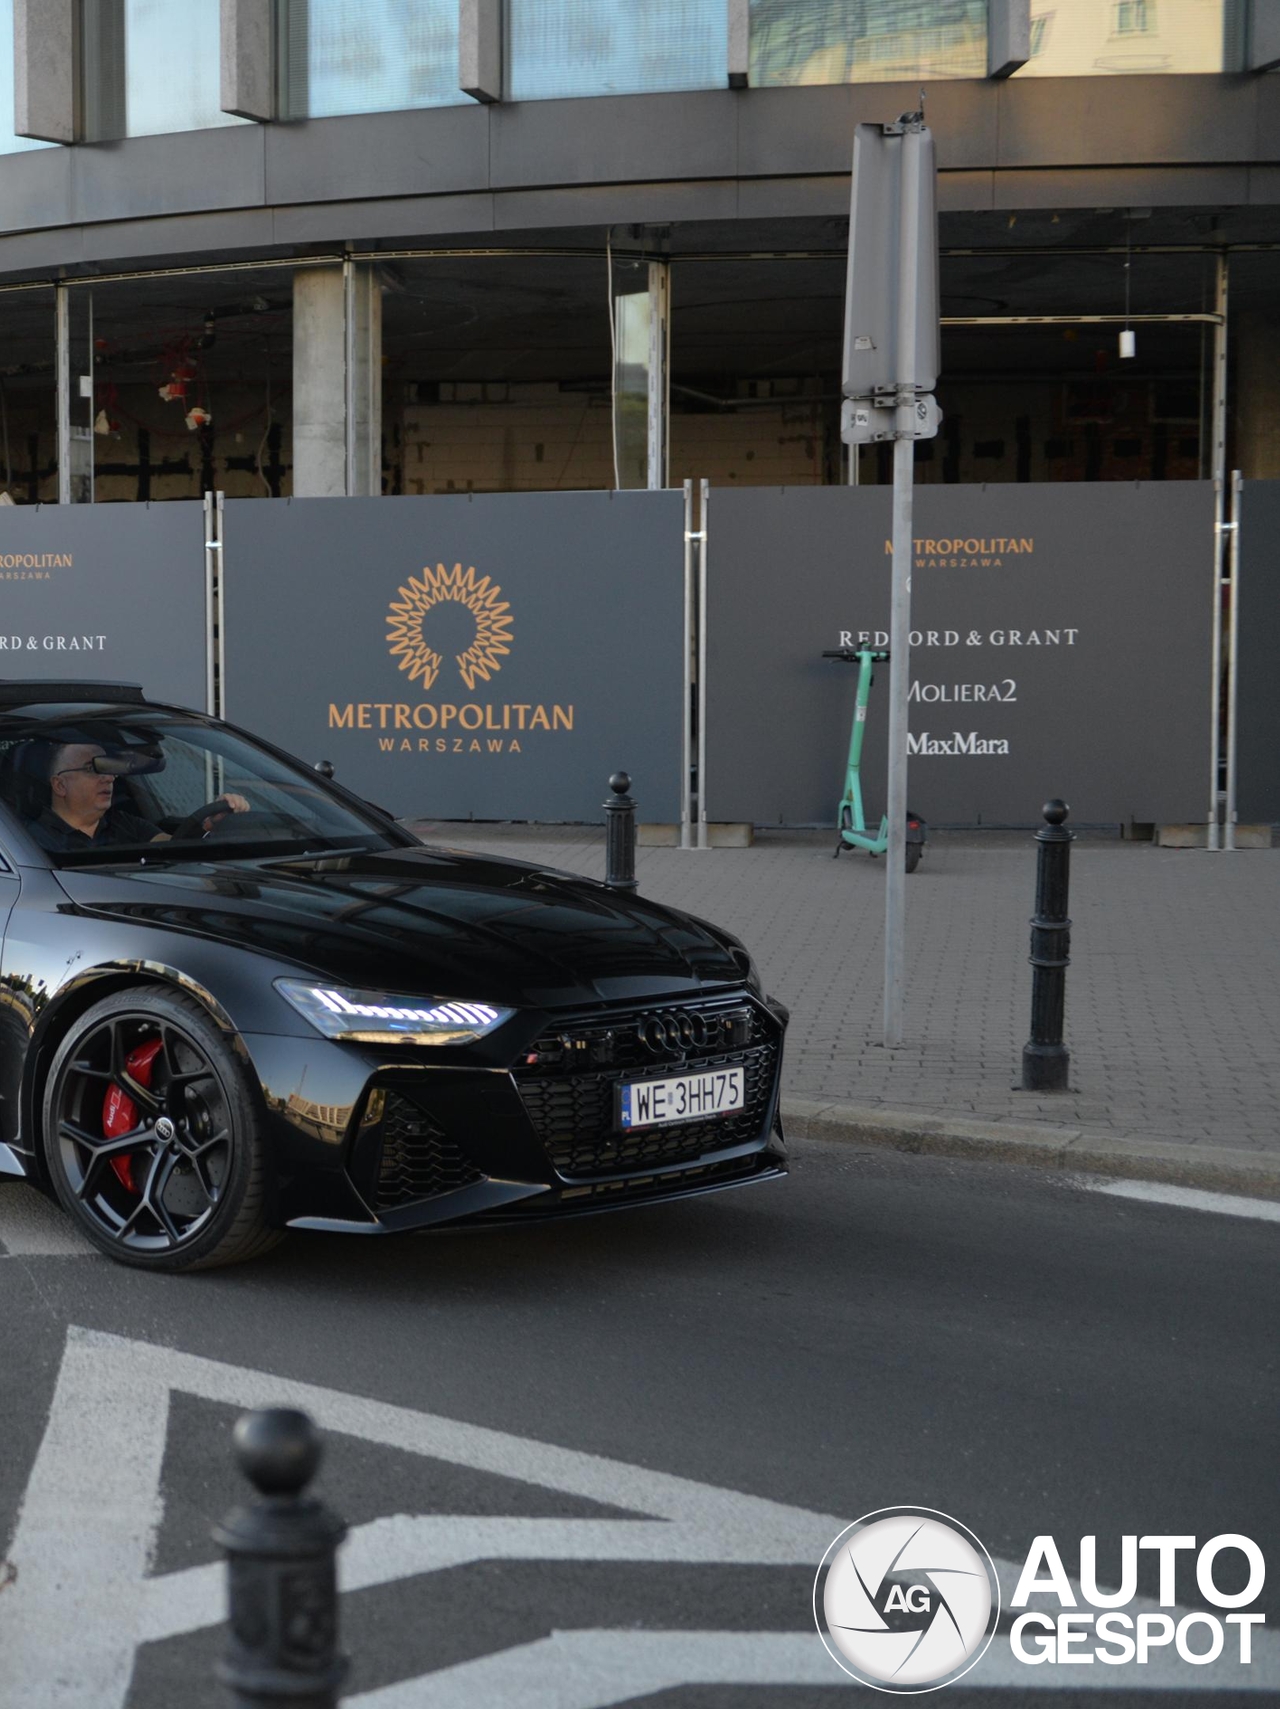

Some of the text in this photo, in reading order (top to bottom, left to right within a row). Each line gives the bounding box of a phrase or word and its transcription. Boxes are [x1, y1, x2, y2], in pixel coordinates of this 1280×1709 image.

[884, 538, 1034, 554] MTROPOLITAN
[915, 558, 1002, 568] WARSZAWA
[26, 635, 38, 650] &
[43, 635, 107, 650] GRANT
[838, 628, 1079, 647] REDORD & GRANT
[328, 703, 574, 730] METROPOLITAN
[378, 738, 522, 753] WARSZAWA
[906, 731, 1009, 755] MaxMara
[637, 1072, 739, 1121] WE 3HH75
[622, 1110, 631, 1121] PL
